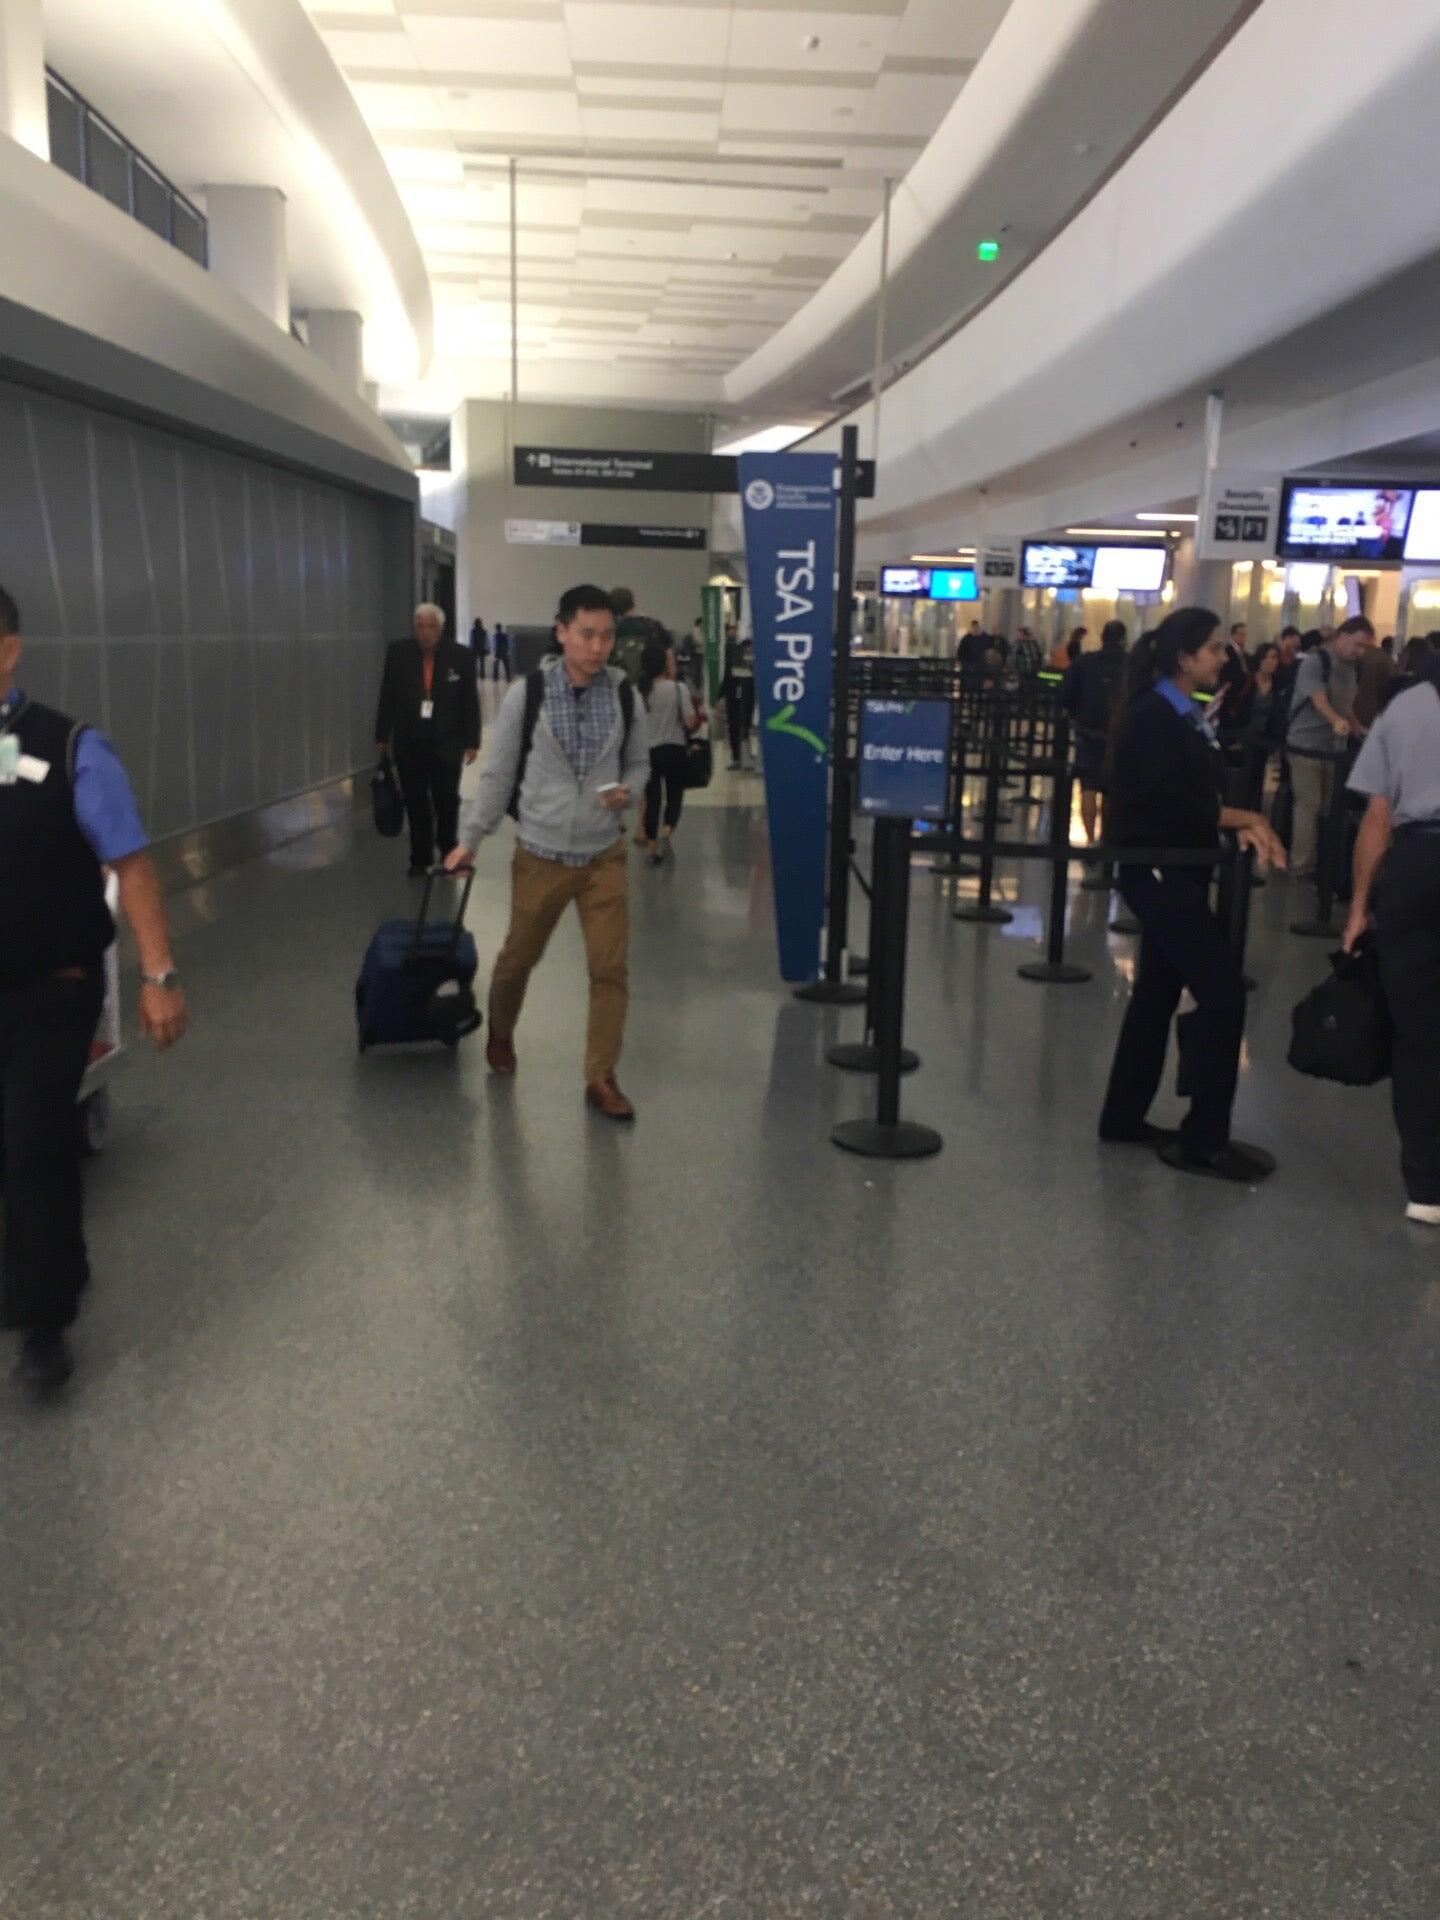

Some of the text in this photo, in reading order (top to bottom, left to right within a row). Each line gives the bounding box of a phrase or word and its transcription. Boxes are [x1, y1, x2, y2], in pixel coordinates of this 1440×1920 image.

[774, 539, 816, 623] TSA
[773, 633, 814, 701] Pre
[863, 744, 944, 763] Enter Here
